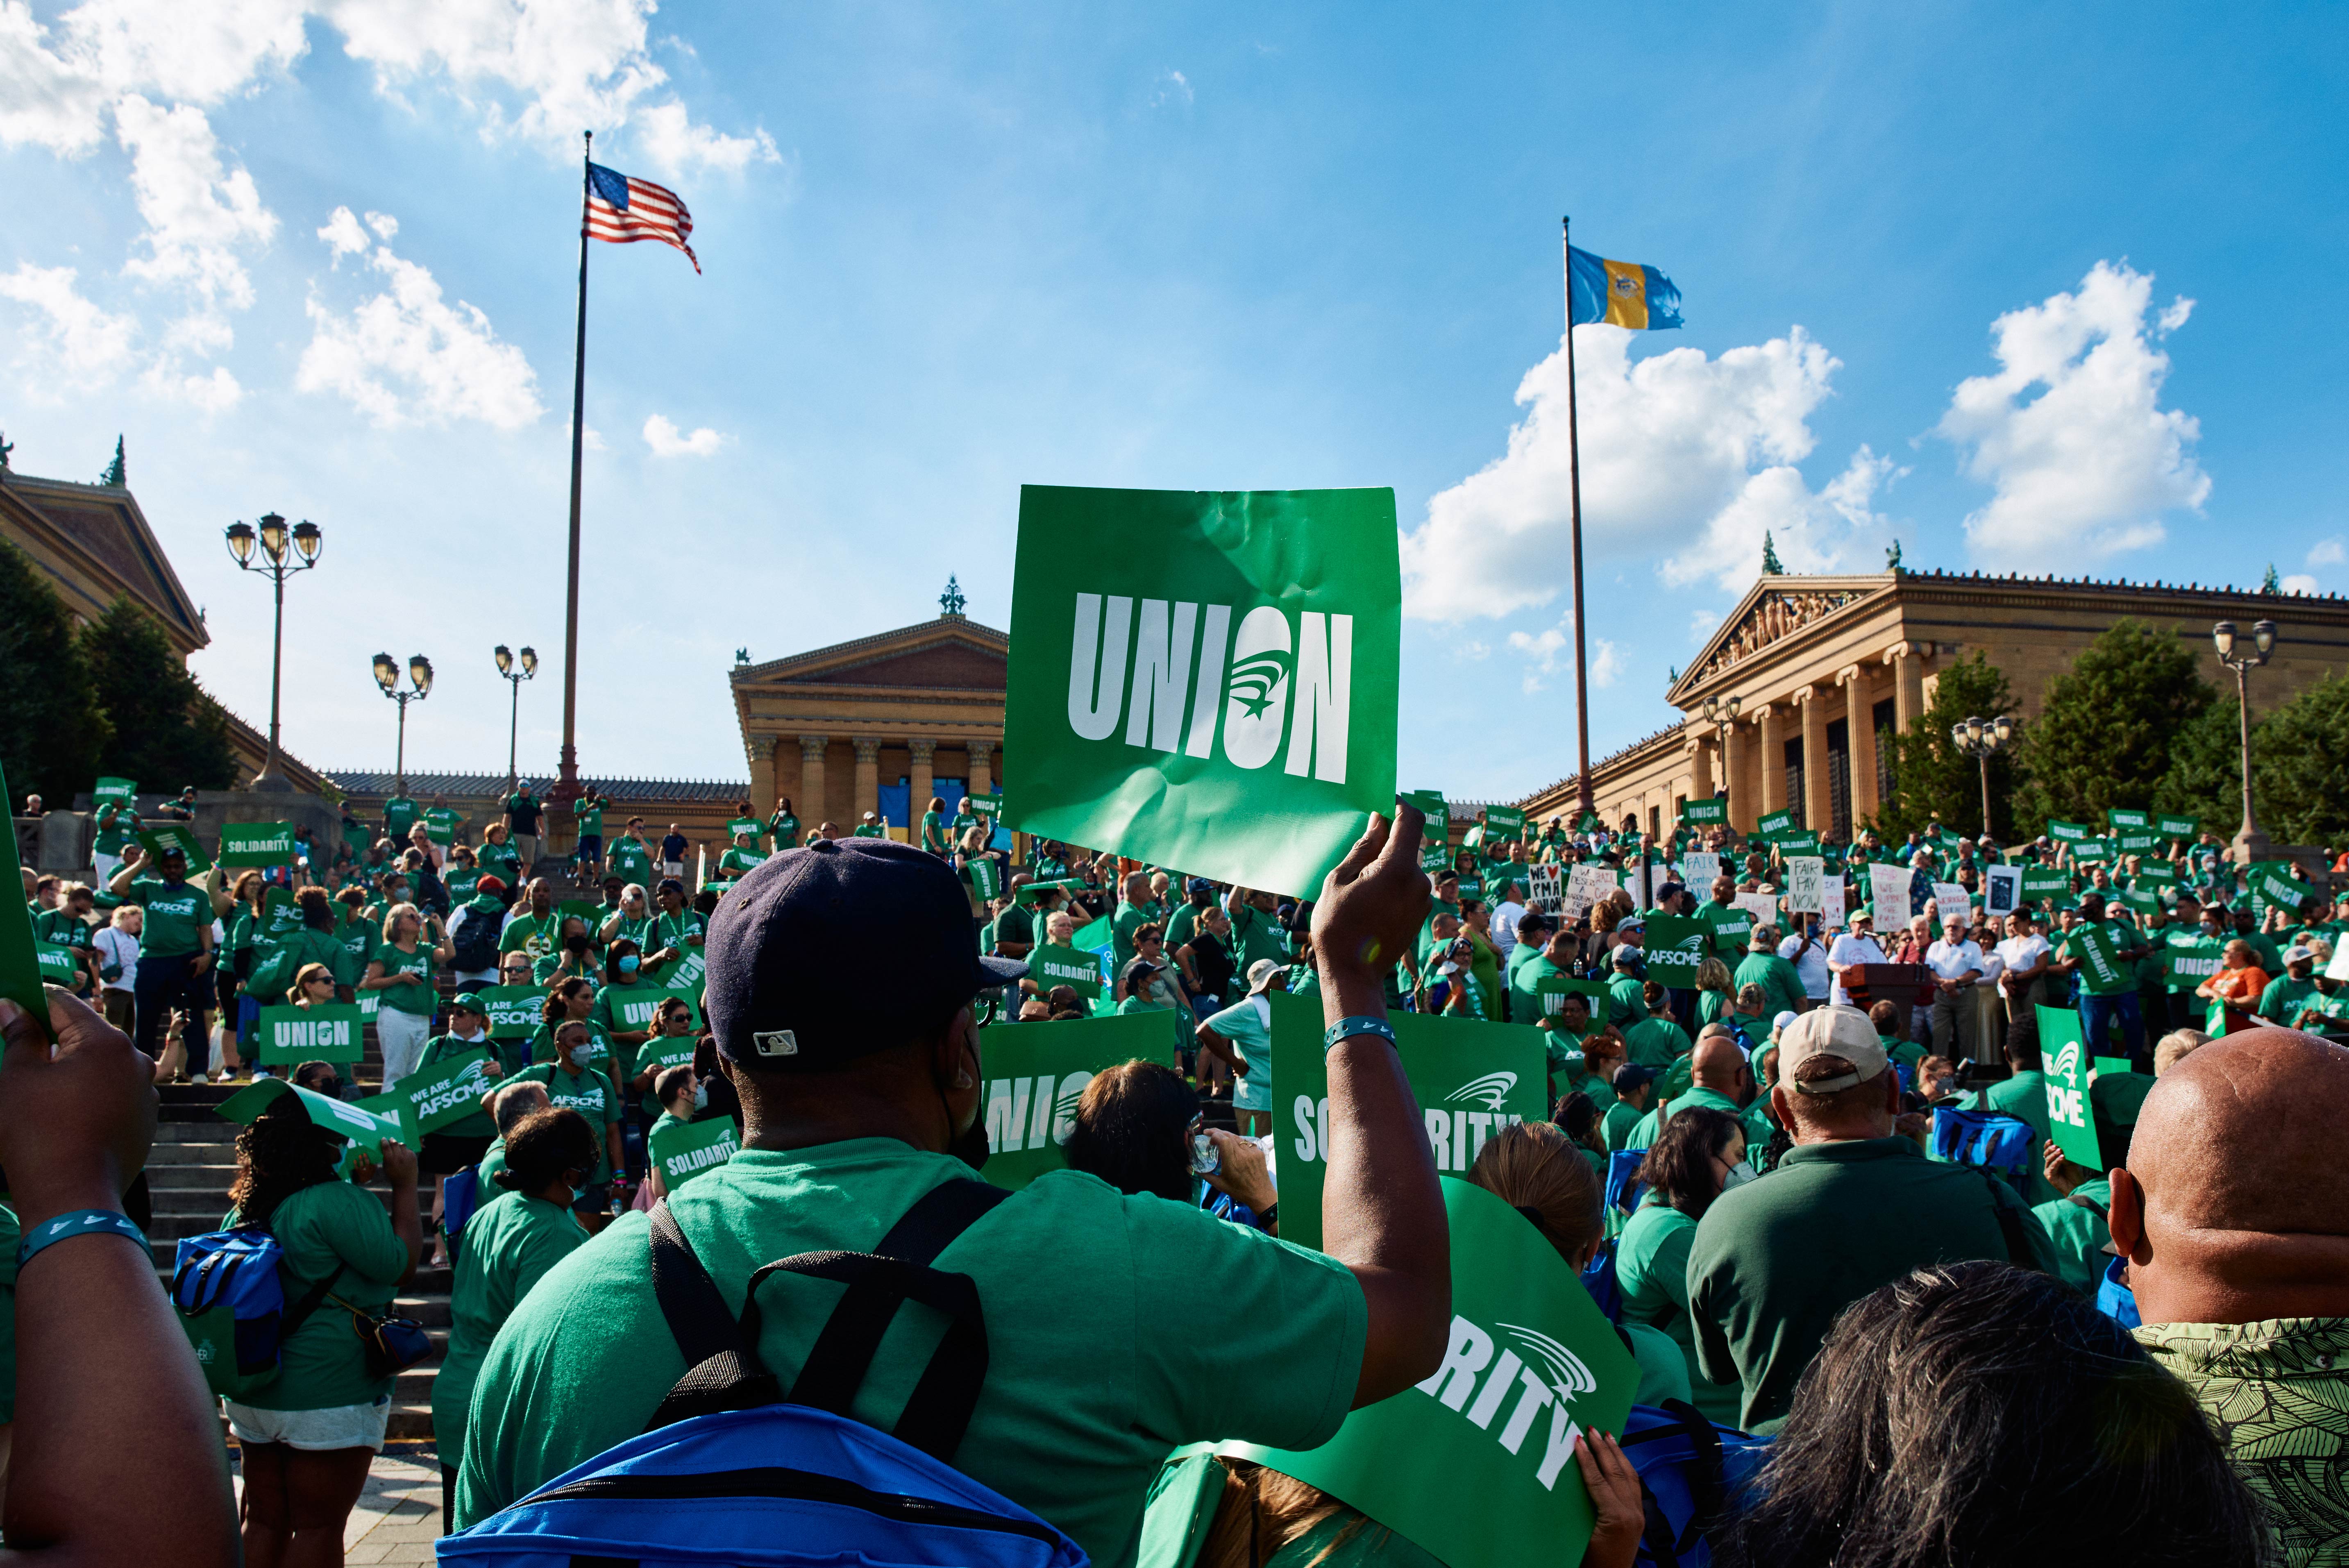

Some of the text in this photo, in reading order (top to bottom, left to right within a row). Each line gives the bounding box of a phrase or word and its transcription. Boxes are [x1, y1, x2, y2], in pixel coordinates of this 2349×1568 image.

[1068, 592, 1353, 784] UNION
[972, 799, 996, 811] UNION
[1689, 806, 1720, 818] UNION
[1489, 815, 1521, 827] SOLIDARITY
[1762, 816, 1789, 833] UNION
[2115, 815, 2144, 826] UNION
[2162, 820, 2193, 834] UNION
[732, 824, 758, 833] UNION
[2054, 826, 2083, 838] UNION
[228, 840, 289, 853] SOLIDARITY
[1780, 840, 1814, 849] SOLIDARITY
[2074, 844, 2103, 855] UNION
[2122, 837, 2151, 849] UNION
[1421, 858, 1446, 869] AFSCME
[1686, 856, 1715, 869] FAIR
[1795, 860, 1819, 876] FAIR
[977, 862, 992, 897] SOLIDARITY
[1530, 866, 1546, 880] WE
[1533, 881, 1559, 897] PMA
[1797, 876, 1817, 891] PAY
[2025, 881, 2067, 890] SOLIDARITY
[2264, 875, 2303, 908] UNION
[149, 901, 194, 913] AFSCME
[1533, 896, 1562, 913] NION
[1793, 894, 1820, 909] NOW
[273, 904, 304, 920] CME
[1716, 922, 1750, 935] SOLIDARITY
[1647, 949, 1702, 966] AFSCME
[2083, 935, 2113, 983] SOLIDARITY
[666, 952, 706, 989] NION
[1044, 962, 1096, 982] SOLIDARITY
[2174, 958, 2224, 976] UNION
[491, 1001, 512, 1010] ARE
[624, 1001, 659, 1024] UNI
[1544, 993, 1600, 1018] UNN
[275, 1021, 349, 1047] UNION
[660, 1052, 695, 1064] WE AR
[410, 1079, 451, 1103] WE ARE
[418, 1076, 491, 1120] AFSCME
[552, 1095, 605, 1108] AFSCME
[982, 1071, 1095, 1155] NIO
[667, 1140, 738, 1176] SOLIDARITY
[1414, 1314, 1583, 1492] RITY
